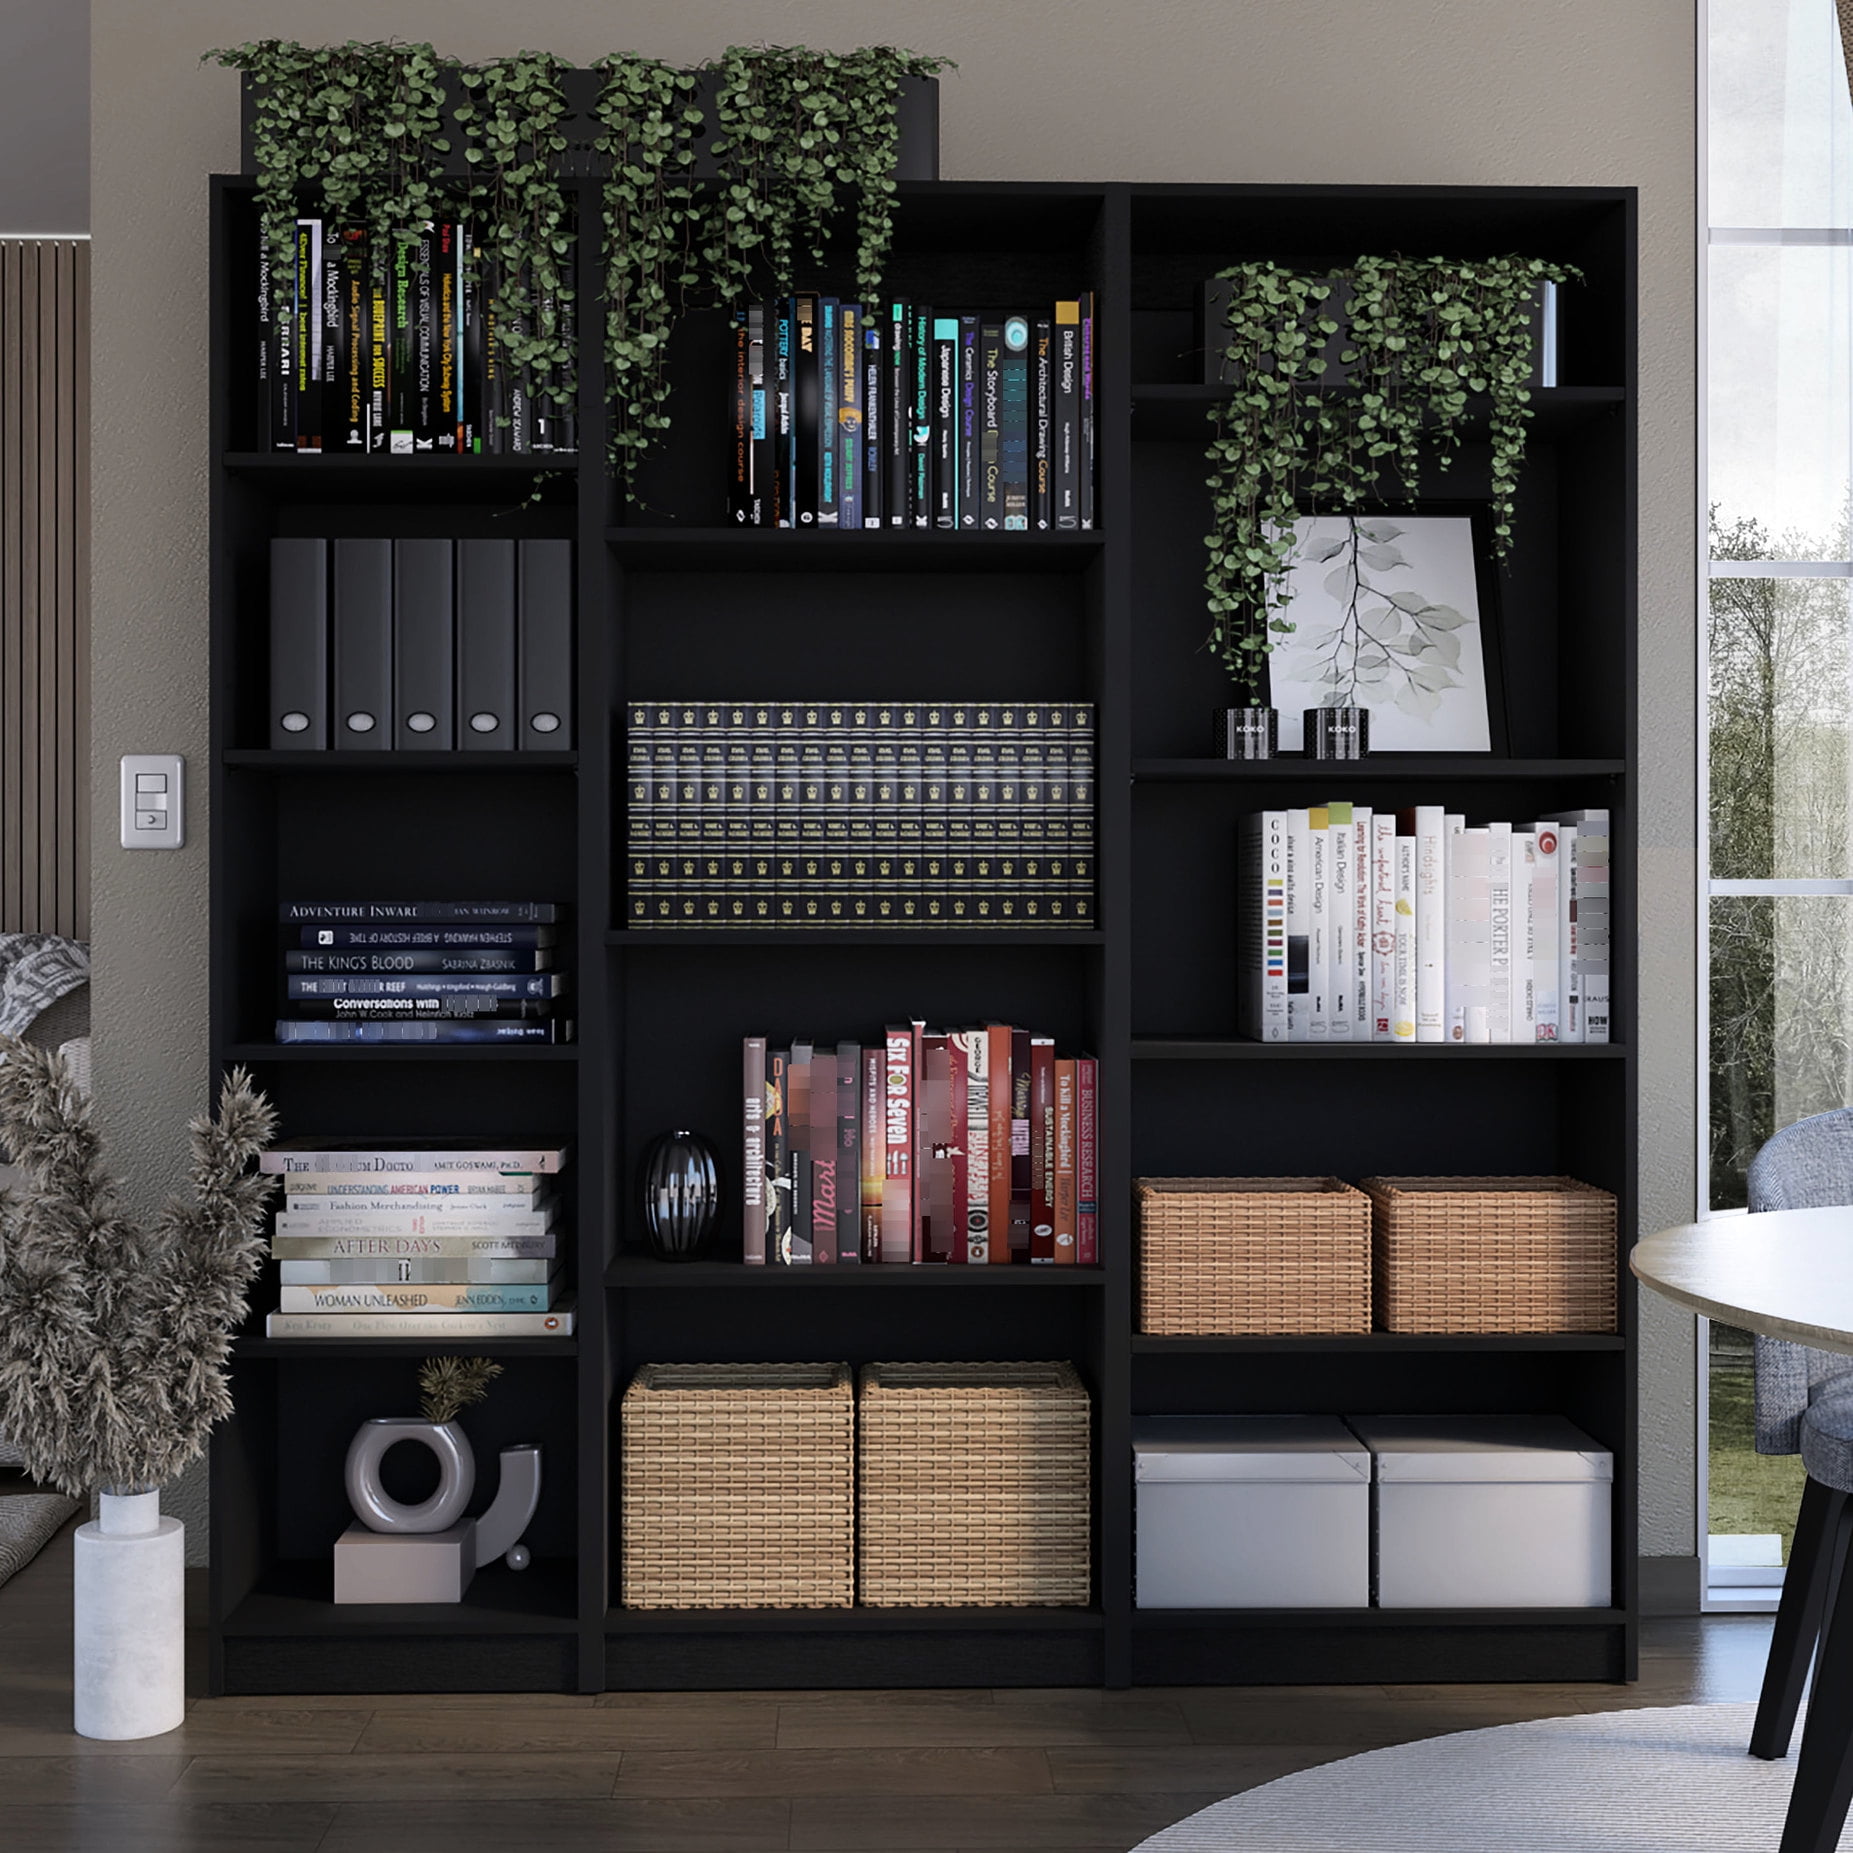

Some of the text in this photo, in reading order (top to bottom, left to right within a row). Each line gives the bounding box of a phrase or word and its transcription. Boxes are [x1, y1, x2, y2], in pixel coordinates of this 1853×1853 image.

[326, 232, 339, 244] To
[395, 242, 409, 277] Design
[259, 261, 270, 322] Mockingbird
[323, 270, 339, 328] Mockingbird
[440, 273, 453, 301] Helvetica
[395, 280, 409, 329] Research
[440, 302, 453, 313] and
[372, 300, 385, 343] BLUEPRINT
[349, 280, 361, 422] Audio Signal Processing and Coding
[419, 286, 430, 392] OF VISUAL COMMUNICATION
[779, 319, 789, 380] POTTERY basics
[259, 340, 268, 380] HARPER LEE
[372, 357, 385, 388] SUCCESS
[917, 316, 927, 420] History of Modern Design
[963, 347, 975, 381] Ceramics
[985, 348, 999, 369] The
[1061, 330, 1073, 394] British Design
[440, 366, 453, 390] Subway
[736, 351, 747, 395] interior
[868, 364, 878, 385] HELEN
[940, 344, 951, 419] Japanese Design
[440, 390, 453, 413] System
[963, 381, 975, 409] Design
[985, 370, 999, 428] Storyboard
[736, 400, 747, 440] design
[1036, 337, 1049, 495] The Architectural Drawing Course
[736, 441, 747, 483] course
[987, 465, 999, 503] Course
[1236, 726, 1265, 734] KOKO
[1328, 726, 1357, 734] KOKO
[1355, 821, 1367, 844] Learning
[1378, 825, 1393, 841] the
[1313, 836, 1324, 914] American Design
[1335, 832, 1347, 895] Italian Design
[1402, 845, 1411, 892] AUTHOR'S NAME
[1420, 835, 1438, 895] Hindsights
[290, 904, 366, 918] ADVENTURE
[349, 933, 440, 944] A BRIEF HISTORY OF TIME
[444, 933, 513, 944] STEPHEN HAWKING
[1492, 905, 1509, 956] PORTER
[301, 955, 415, 971] THE KING'S BLOOD
[300, 982, 319, 993] THE
[385, 982, 407, 993] REEF
[333, 998, 440, 1010] Conversations with
[335, 1009, 453, 1019] John Cook and Heinrich
[868, 1058, 878, 1086] MISFITS
[1058, 1074, 1071, 1087] To
[745, 1097, 764, 1121] arts
[868, 1087, 878, 1105] AND
[1058, 1087, 1071, 1105] Kill
[868, 1105, 878, 1134] HEROES
[1081, 1089, 1094, 1140] BUSINESS
[1058, 1111, 1071, 1168] Mockingbird
[283, 1157, 310, 1172] THE
[456, 1161, 499, 1170] GOSWAMI,
[745, 1137, 764, 1206] architecture
[1045, 1106, 1054, 1209] SUSTAINABLE ENERGY
[1081, 1141, 1094, 1198] RESEARCH
[327, 1185, 390, 1194] UNDERSTANDING
[390, 1185, 430, 1194] AMERICAN
[430, 1185, 459, 1194] POWER
[1058, 1177, 1071, 1222] Harper Lee
[330, 1200, 443, 1212] Fashion Merchandising
[333, 1240, 442, 1254] AFTER DAYS
[471, 1240, 500, 1250] SCOTT
[314, 1294, 429, 1307] WOMAN UNLEASHED
[284, 1319, 333, 1332] Ken Kesey
